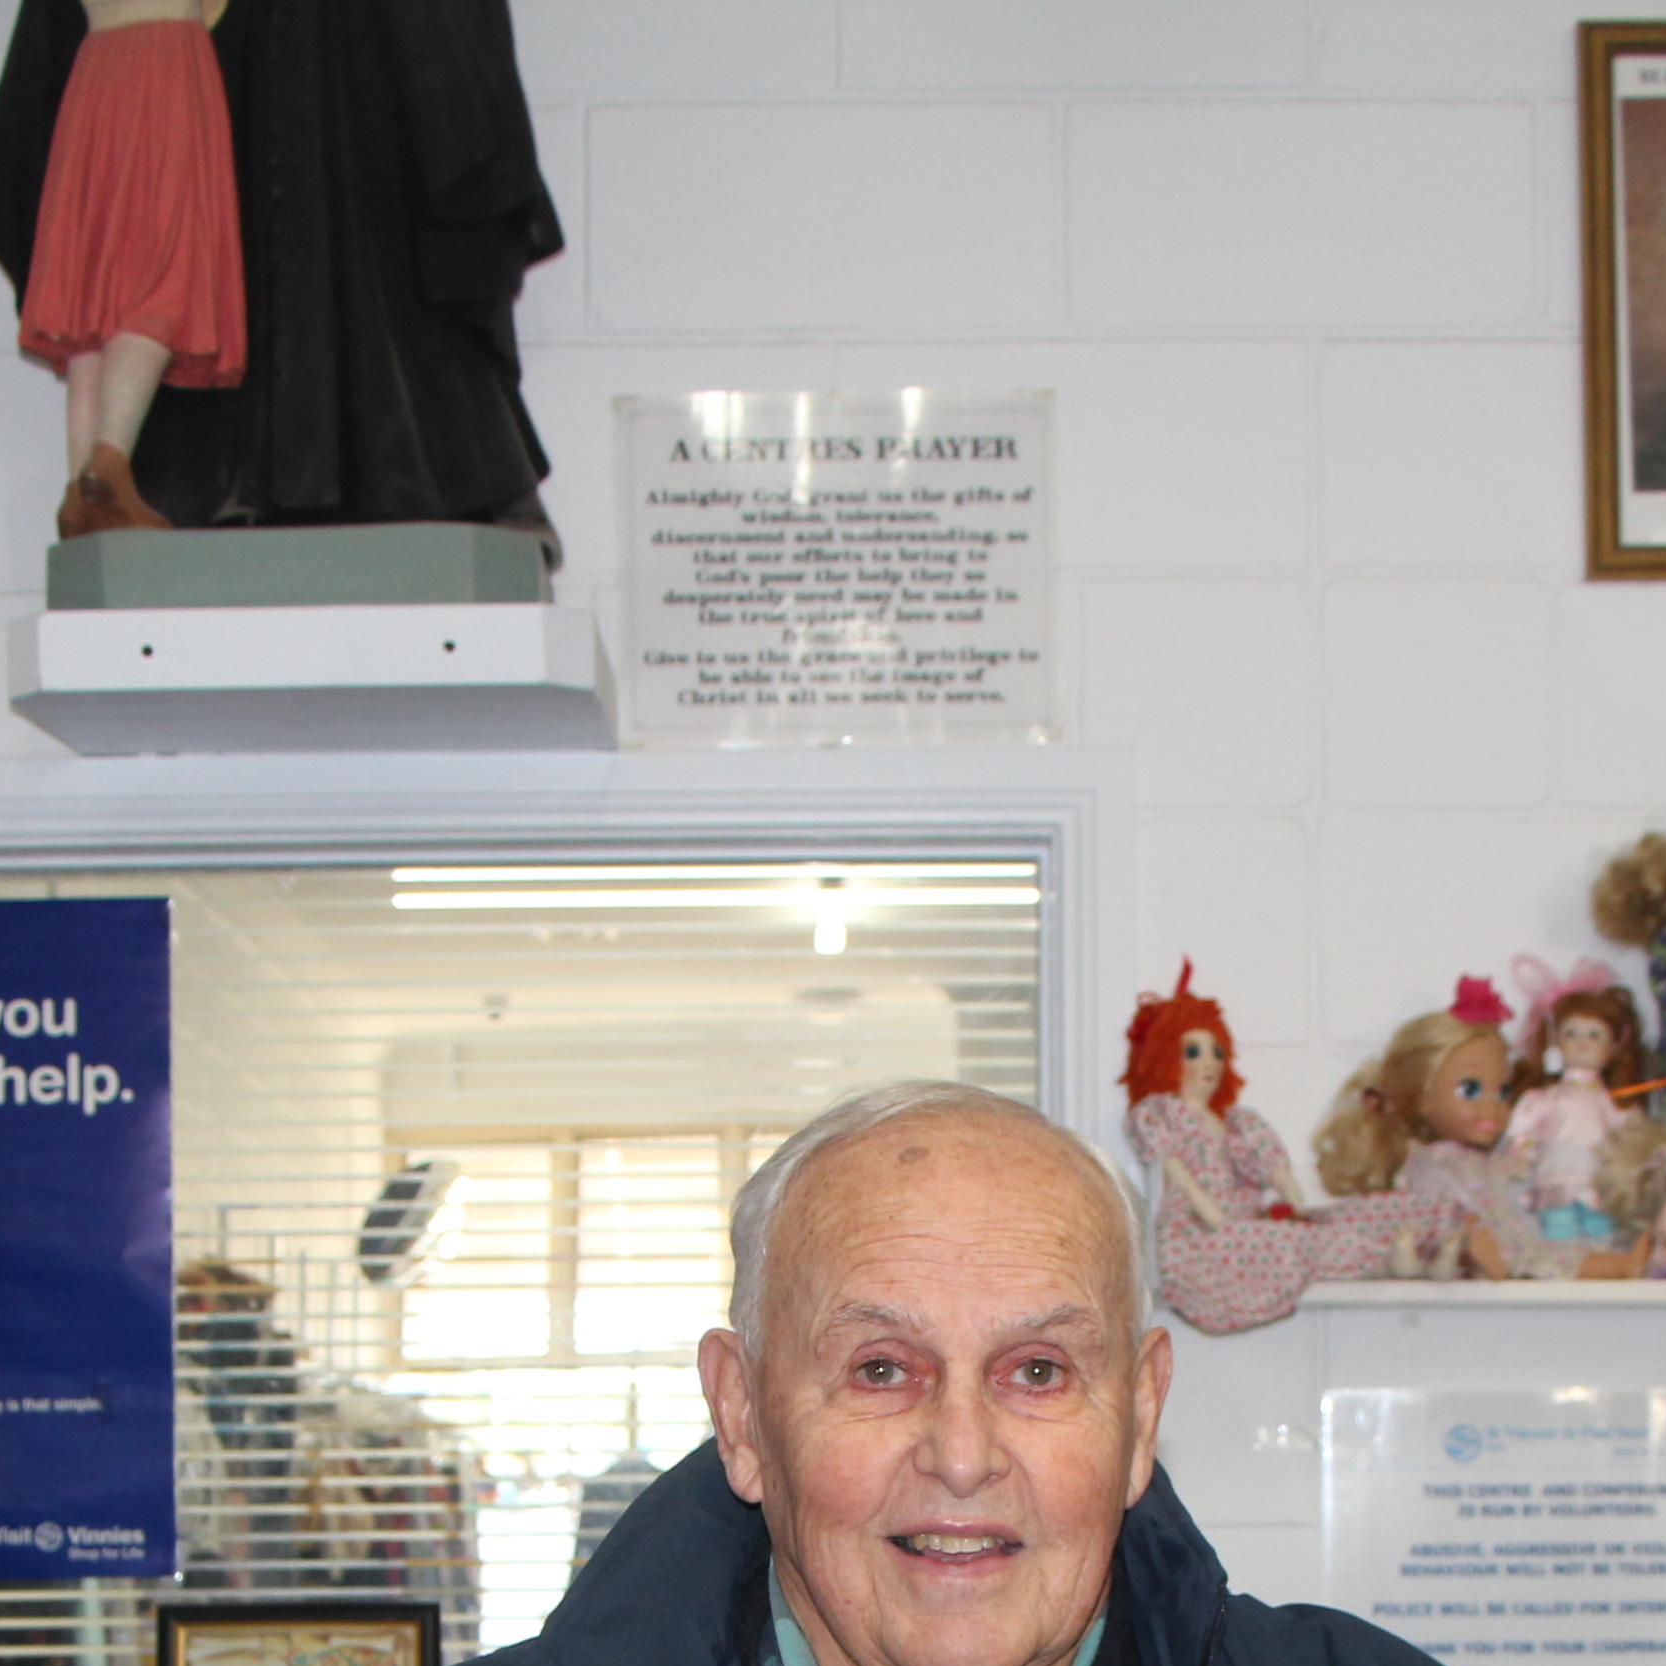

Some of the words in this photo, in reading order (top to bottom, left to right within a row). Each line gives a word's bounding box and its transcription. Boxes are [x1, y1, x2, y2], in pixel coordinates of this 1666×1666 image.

[670, 438, 690, 463] A
[877, 436, 1017, 460] PRAYER
[645, 489, 743, 508] Almighty
[810, 492, 873, 508] grant
[878, 492, 903, 502] us
[911, 488, 946, 502] the
[954, 488, 1003, 507] gifts
[1013, 487, 1034, 502] of
[651, 529, 785, 543] discernment
[795, 529, 833, 543] and
[1006, 532, 1028, 543] so
[694, 549, 737, 563] that
[746, 551, 784, 563] our
[792, 549, 863, 563] efforts
[871, 549, 892, 563] to
[899, 548, 958, 565] bring
[968, 549, 988, 561] to
[695, 568, 751, 583] God's
[760, 571, 806, 586] poor
[815, 568, 849, 582] the
[858, 568, 903, 586] help
[910, 568, 954, 585] they
[963, 571, 985, 582] so
[662, 590, 787, 606] desperately
[793, 589, 844, 602] need
[853, 591, 894, 606] may
[902, 588, 926, 601] be
[934, 589, 987, 601] made
[996, 588, 1018, 601] in
[699, 609, 732, 624] the
[740, 609, 787, 624] true
[896, 608, 936, 621] love
[945, 608, 983, 621] and
[644, 650, 689, 665] Give
[696, 650, 716, 664] to
[915, 648, 1012, 666] privilege
[1019, 649, 1038, 662] to
[699, 670, 722, 684] be
[730, 669, 774, 683] able
[781, 670, 801, 683] to
[963, 668, 985, 682] of
[677, 689, 748, 704] Christ
[756, 690, 779, 703] in
[787, 689, 817, 703] all
[861, 689, 907, 703] seek
[917, 690, 936, 702] to
[22, 1399, 50, 1412] that
[68, 1527, 145, 1544] Vinnies
